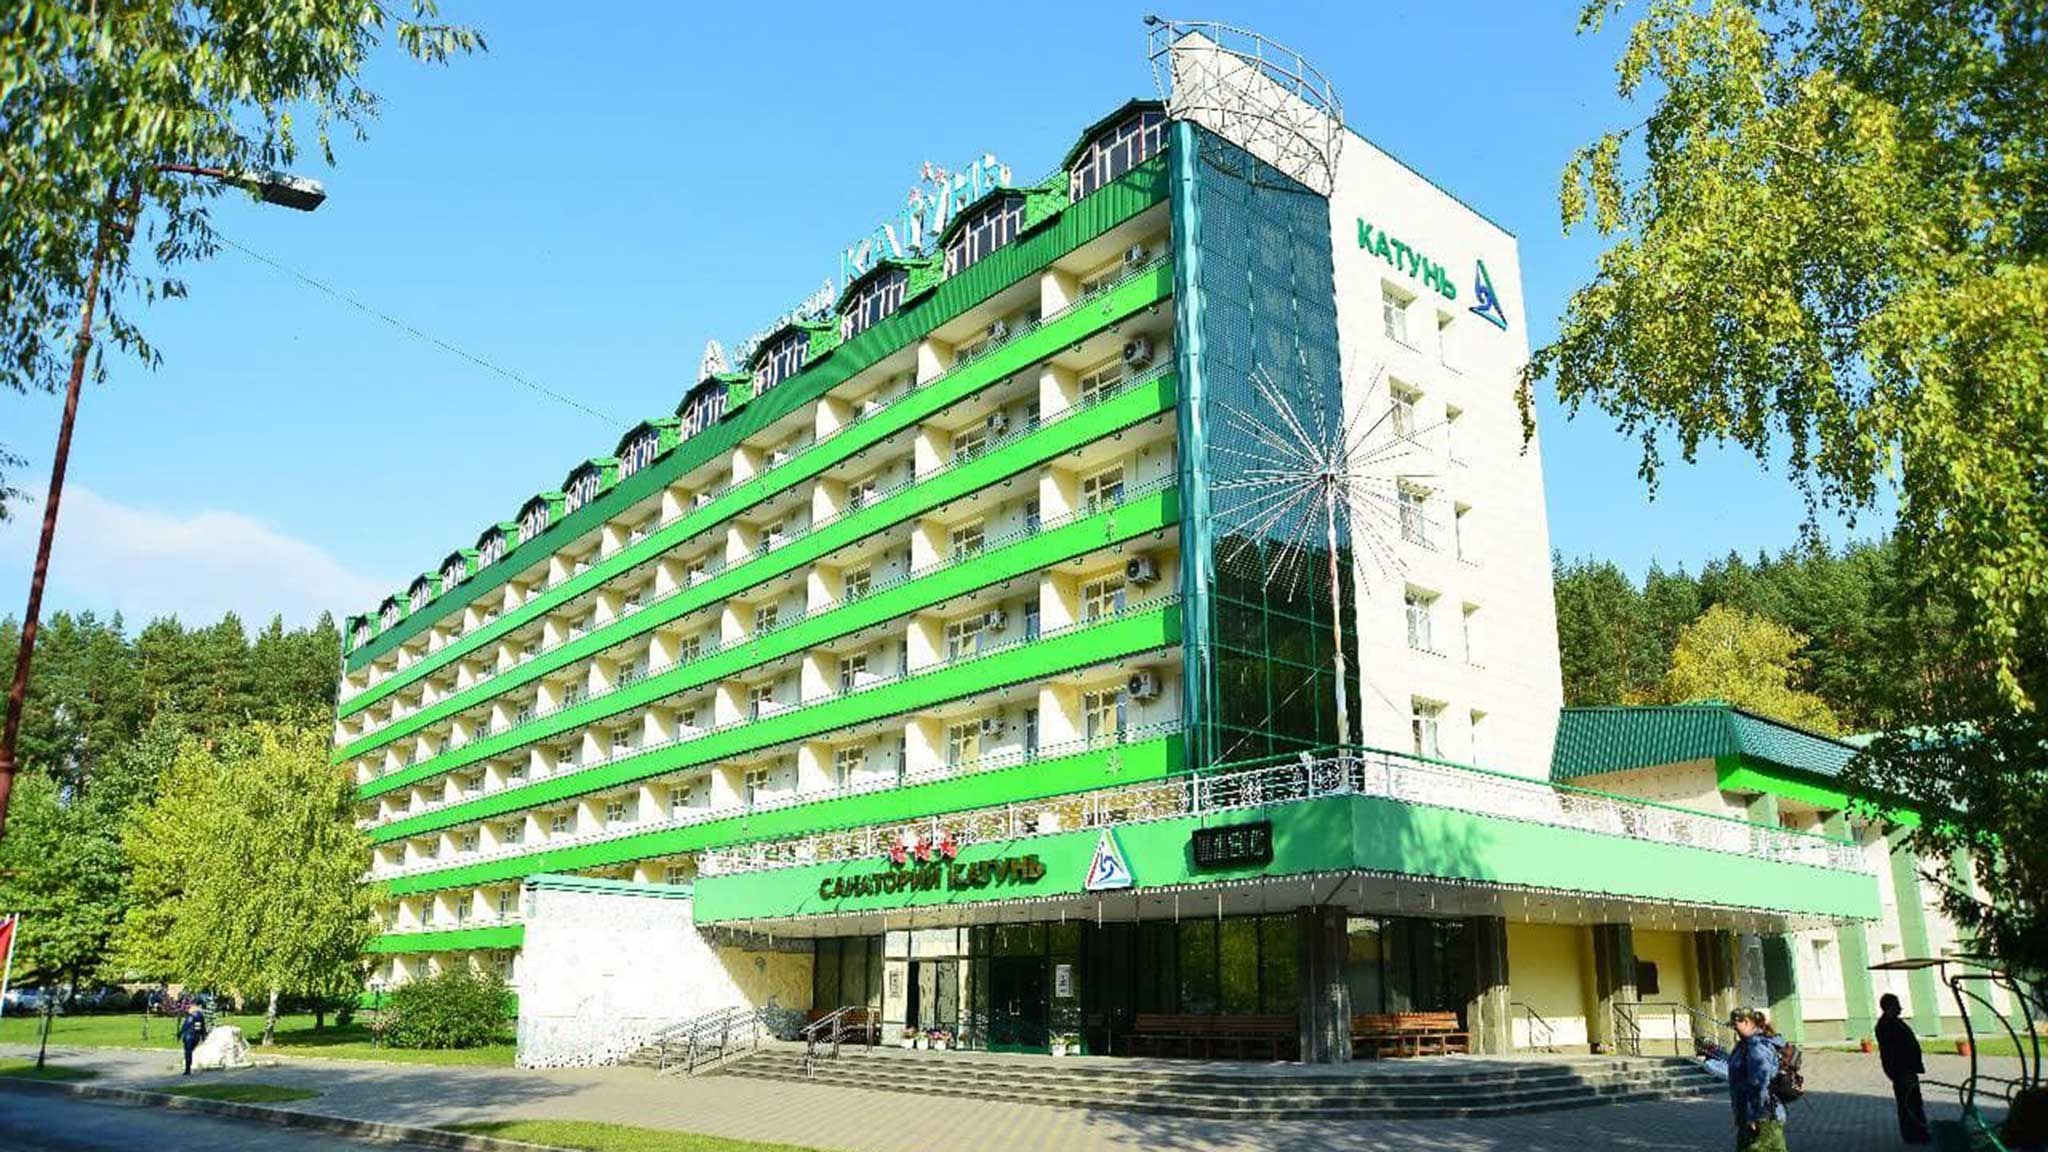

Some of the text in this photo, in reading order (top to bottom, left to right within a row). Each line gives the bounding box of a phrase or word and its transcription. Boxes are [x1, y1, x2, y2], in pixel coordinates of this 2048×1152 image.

[1356, 217, 1457, 300] КАТУНЬ
[819, 855, 1047, 901] САНАТОРИЙ КАТУНЬ
